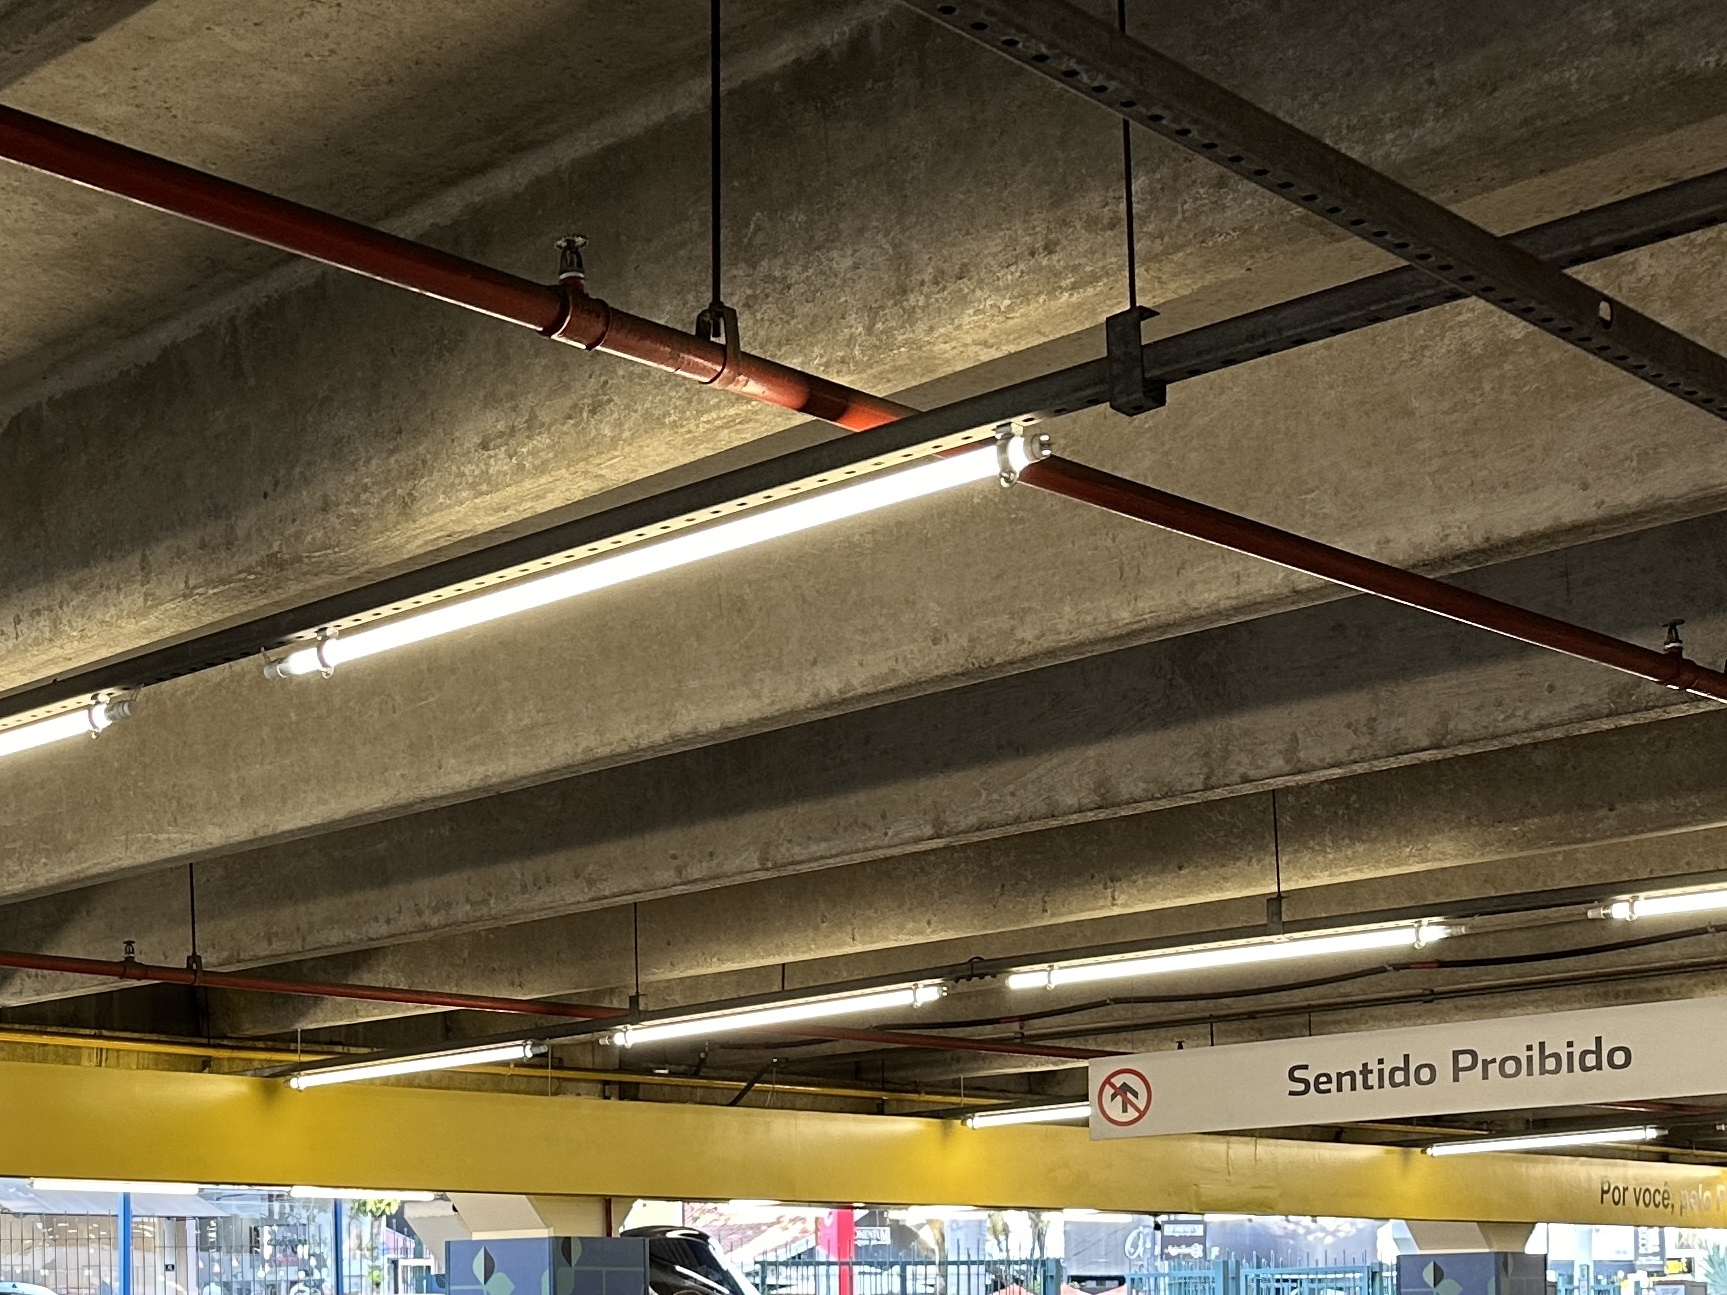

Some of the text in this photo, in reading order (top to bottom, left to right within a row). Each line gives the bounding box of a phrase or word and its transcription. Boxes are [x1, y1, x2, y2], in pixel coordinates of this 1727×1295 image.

[1287, 1035, 1632, 1096] Sentido Proibido
[1600, 1179, 1629, 1206] Por
[1633, 1181, 1675, 1215] você,
